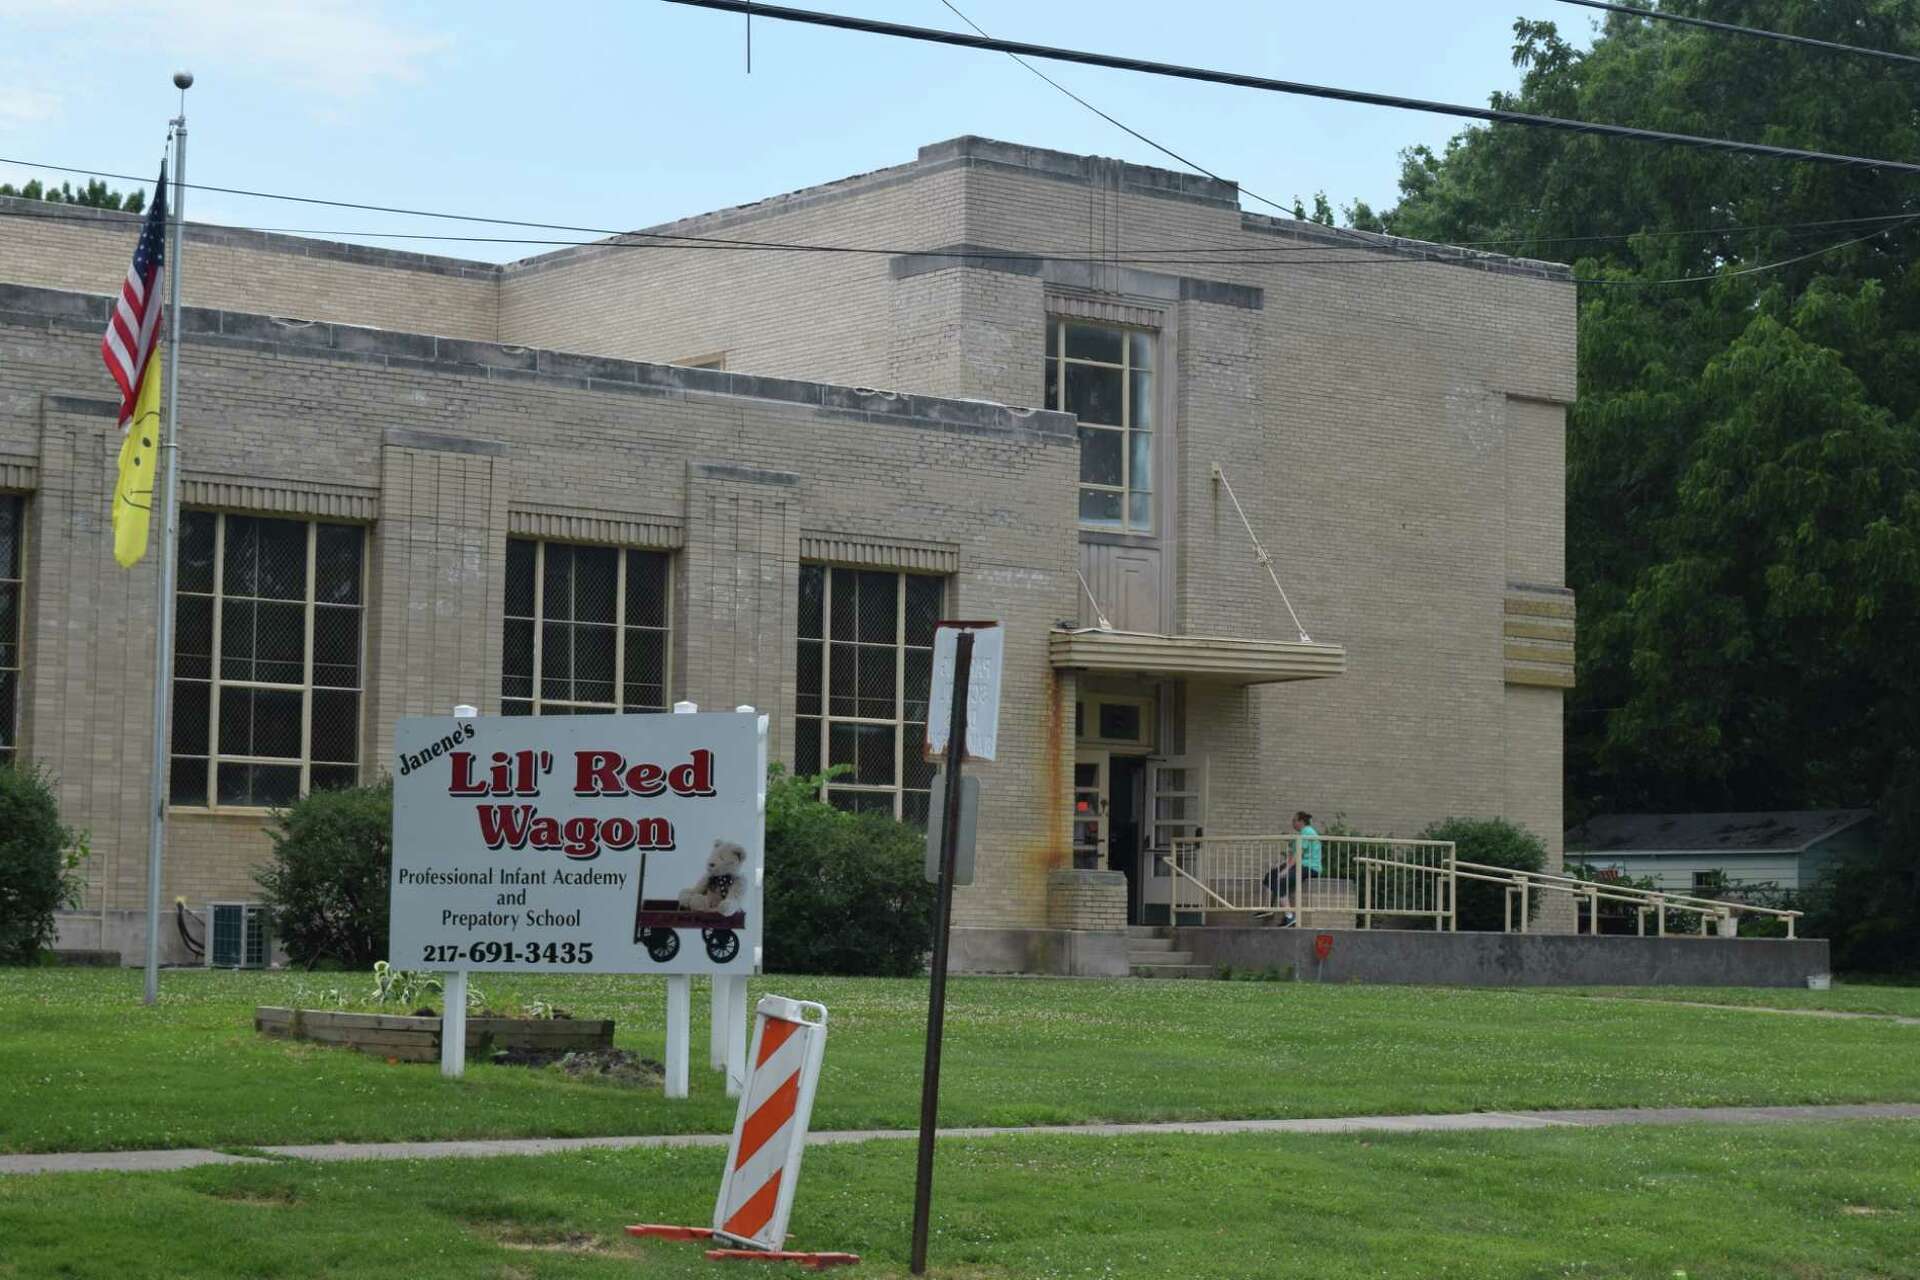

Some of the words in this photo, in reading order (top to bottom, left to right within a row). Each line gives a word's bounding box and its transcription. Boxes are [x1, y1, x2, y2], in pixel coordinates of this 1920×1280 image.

[399, 721, 475, 776] Janene's
[448, 750, 553, 797] Lil'
[572, 748, 716, 797] Red
[475, 804, 676, 860] Wagon
[399, 867, 493, 885] Professional
[500, 868, 546, 885] Infant
[553, 867, 627, 890] Academy
[497, 888, 526, 905] and
[442, 909, 520, 931] Prepatory
[526, 909, 581, 927] School
[423, 941, 593, 964] 217-691-3435
